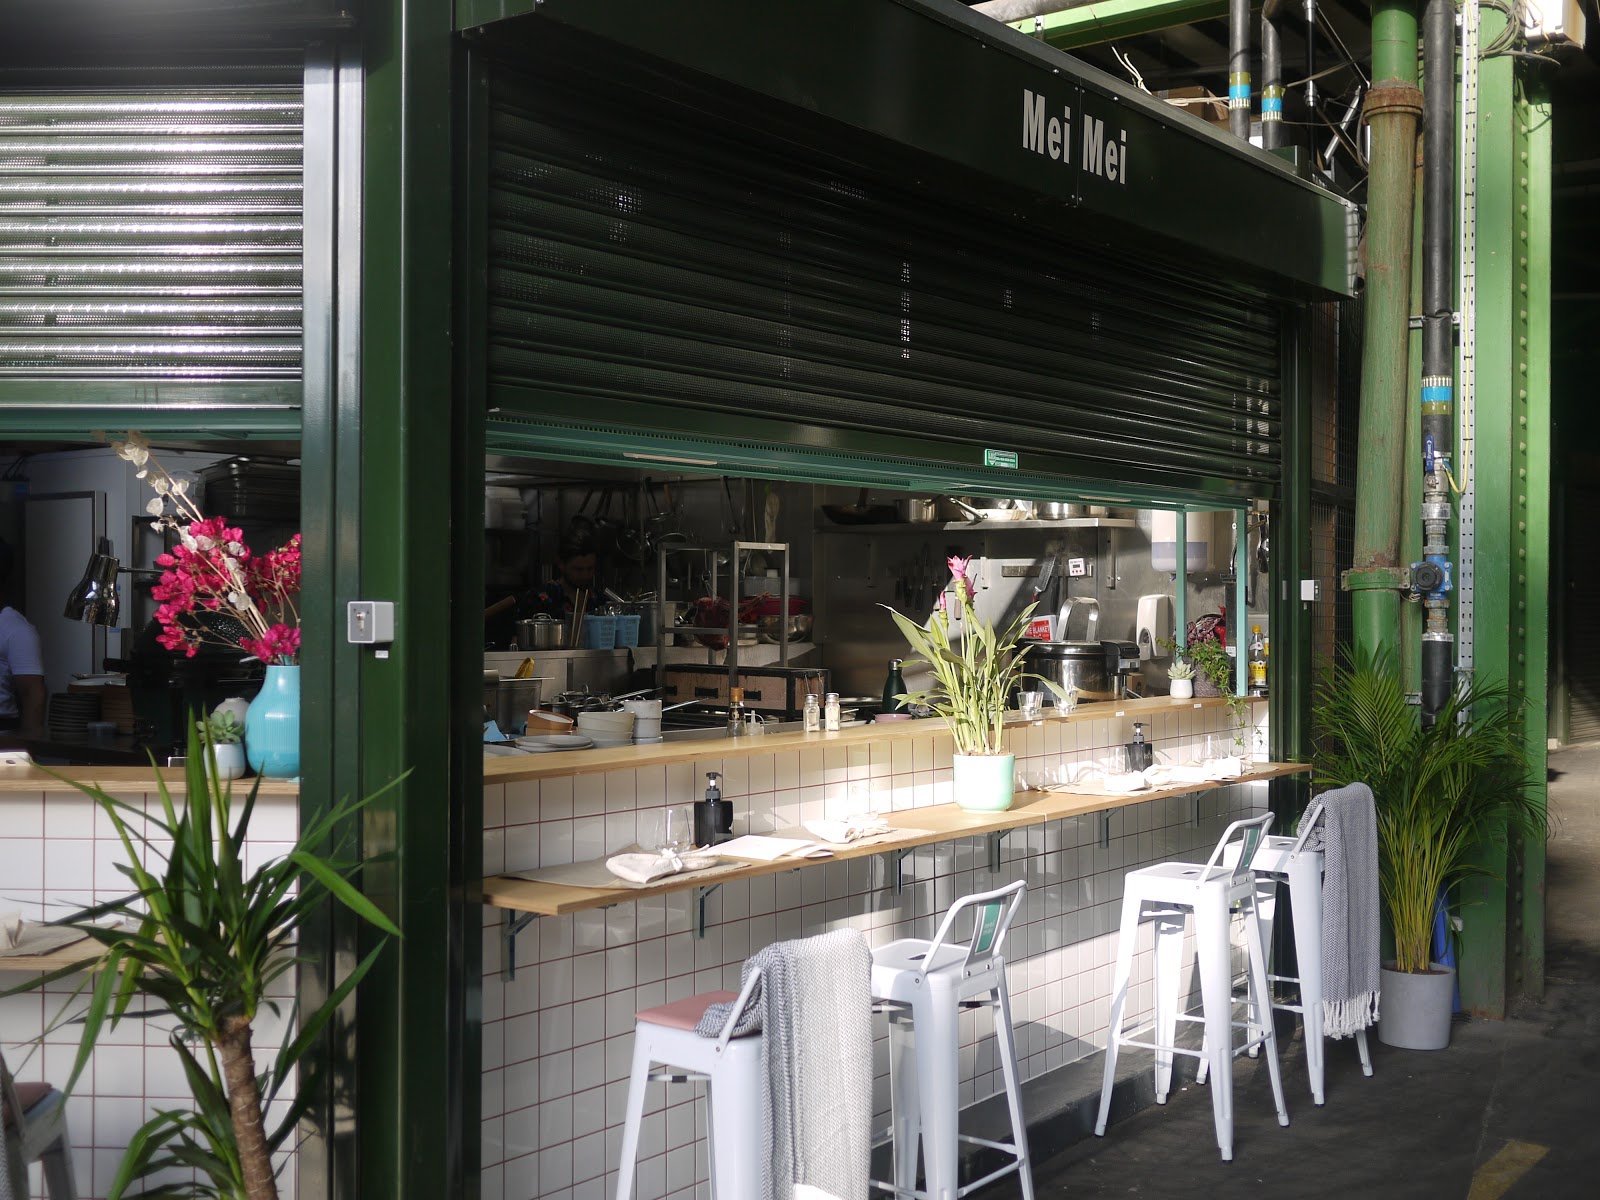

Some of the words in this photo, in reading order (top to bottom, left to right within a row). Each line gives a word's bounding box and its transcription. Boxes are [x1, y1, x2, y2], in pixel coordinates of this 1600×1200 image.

[1023, 88, 1071, 164] Mei
[1083, 114, 1127, 184] Mei
[1033, 625, 1050, 634] BLANKET
